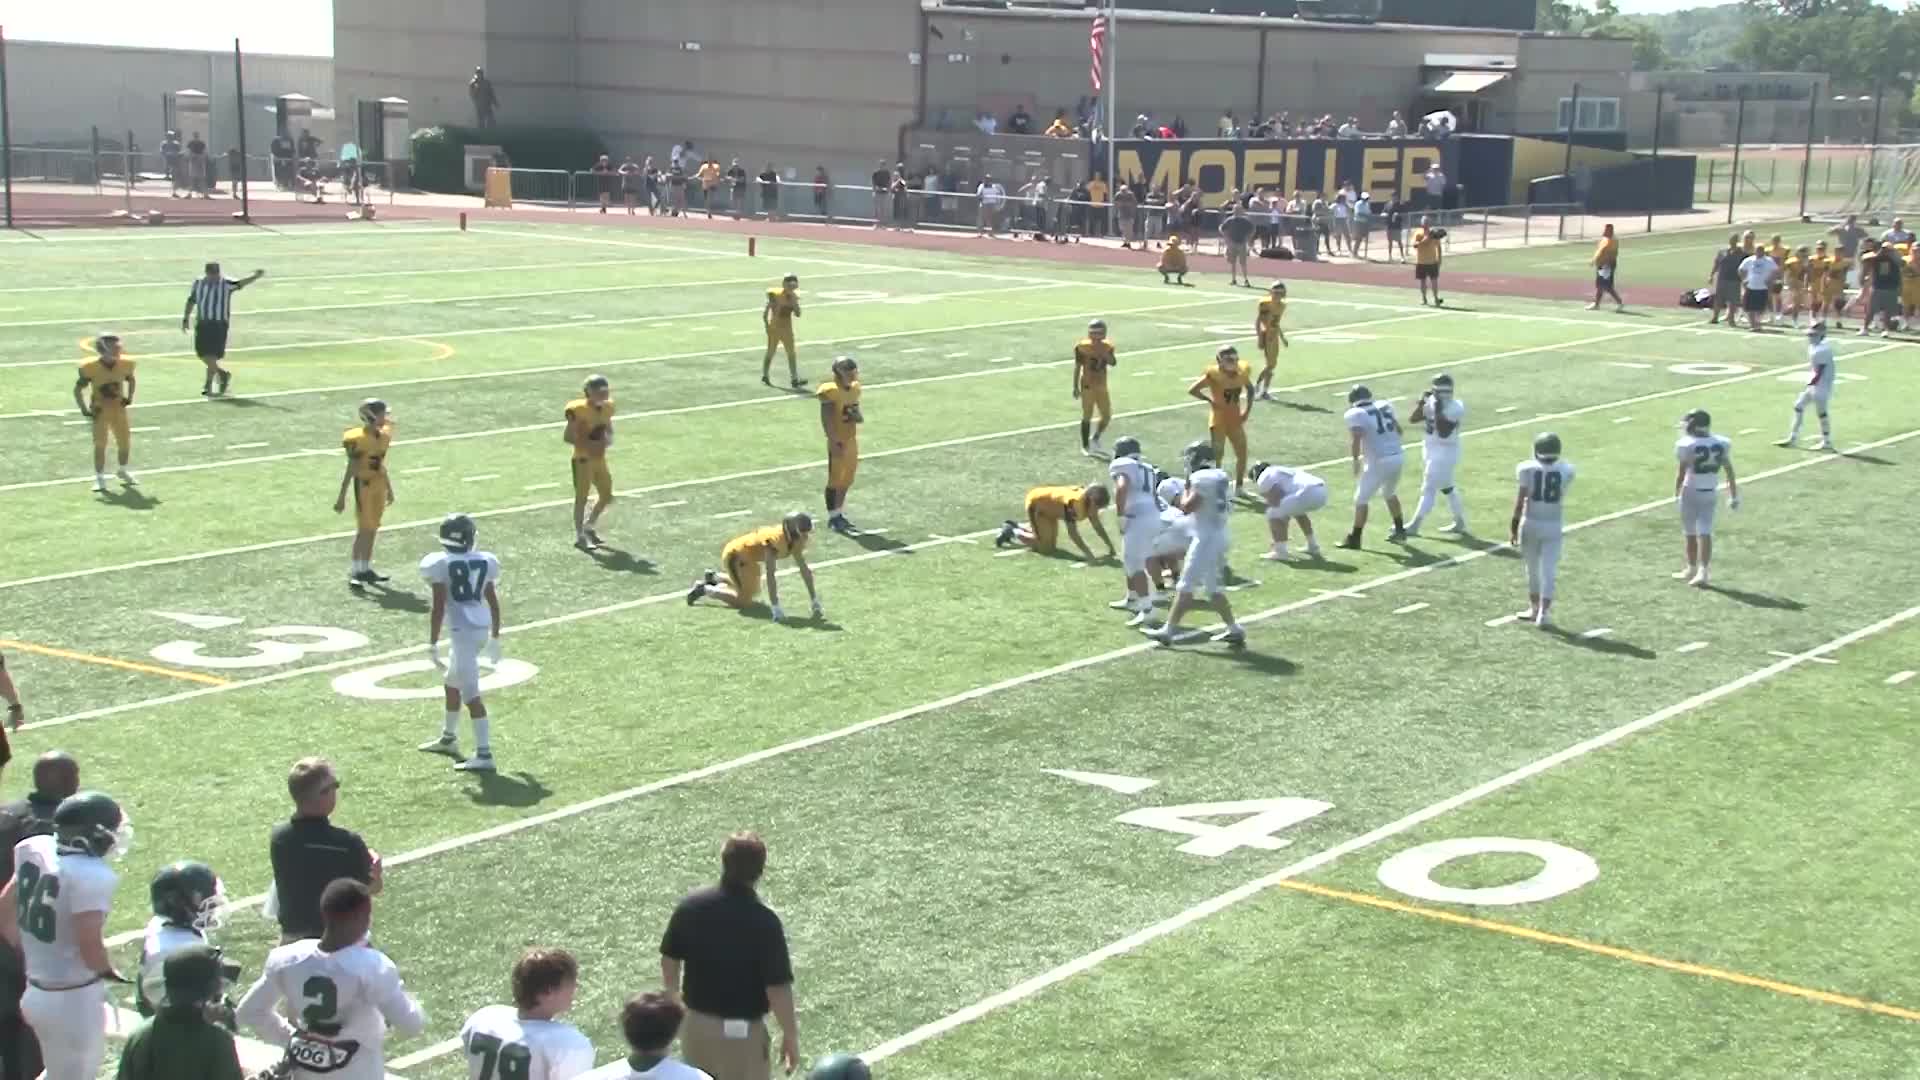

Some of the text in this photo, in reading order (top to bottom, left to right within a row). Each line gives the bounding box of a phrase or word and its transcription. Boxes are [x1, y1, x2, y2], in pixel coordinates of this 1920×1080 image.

[1694, 445, 1725, 474] 22
[1532, 470, 1562, 503] 18
[448, 559, 488, 603] 87
[17, 861, 60, 944] 86
[302, 976, 343, 1035] 2
